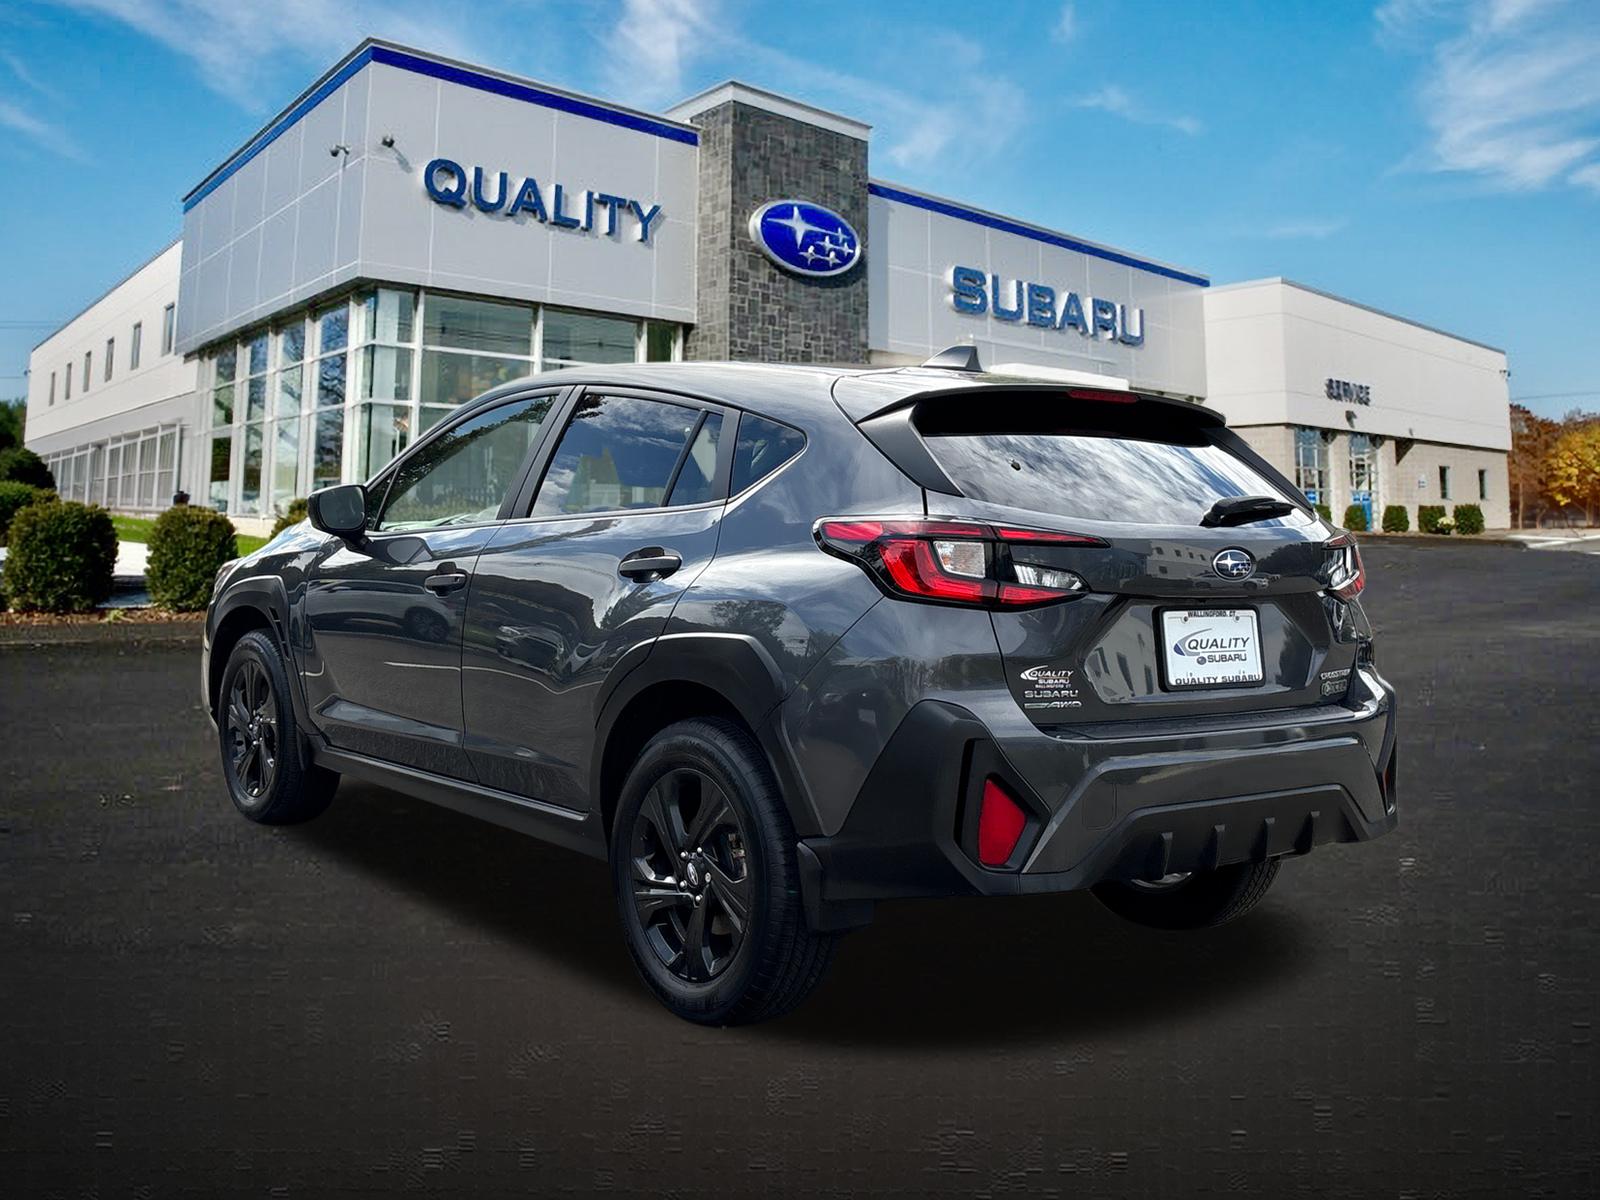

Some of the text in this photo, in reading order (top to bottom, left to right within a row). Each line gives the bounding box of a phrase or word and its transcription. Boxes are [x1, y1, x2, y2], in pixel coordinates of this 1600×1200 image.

[424, 158, 662, 243] QUALITY
[952, 265, 1145, 346] SUBARU
[1325, 378, 1371, 407] SERVICE
[1187, 637, 1250, 651] QUALITY
[1207, 653, 1247, 663] SUBARU
[1175, 674, 1261, 685] QUALITY SUBARU
[1024, 690, 1079, 698] SUBARU
[1047, 701, 1082, 709] AWD
